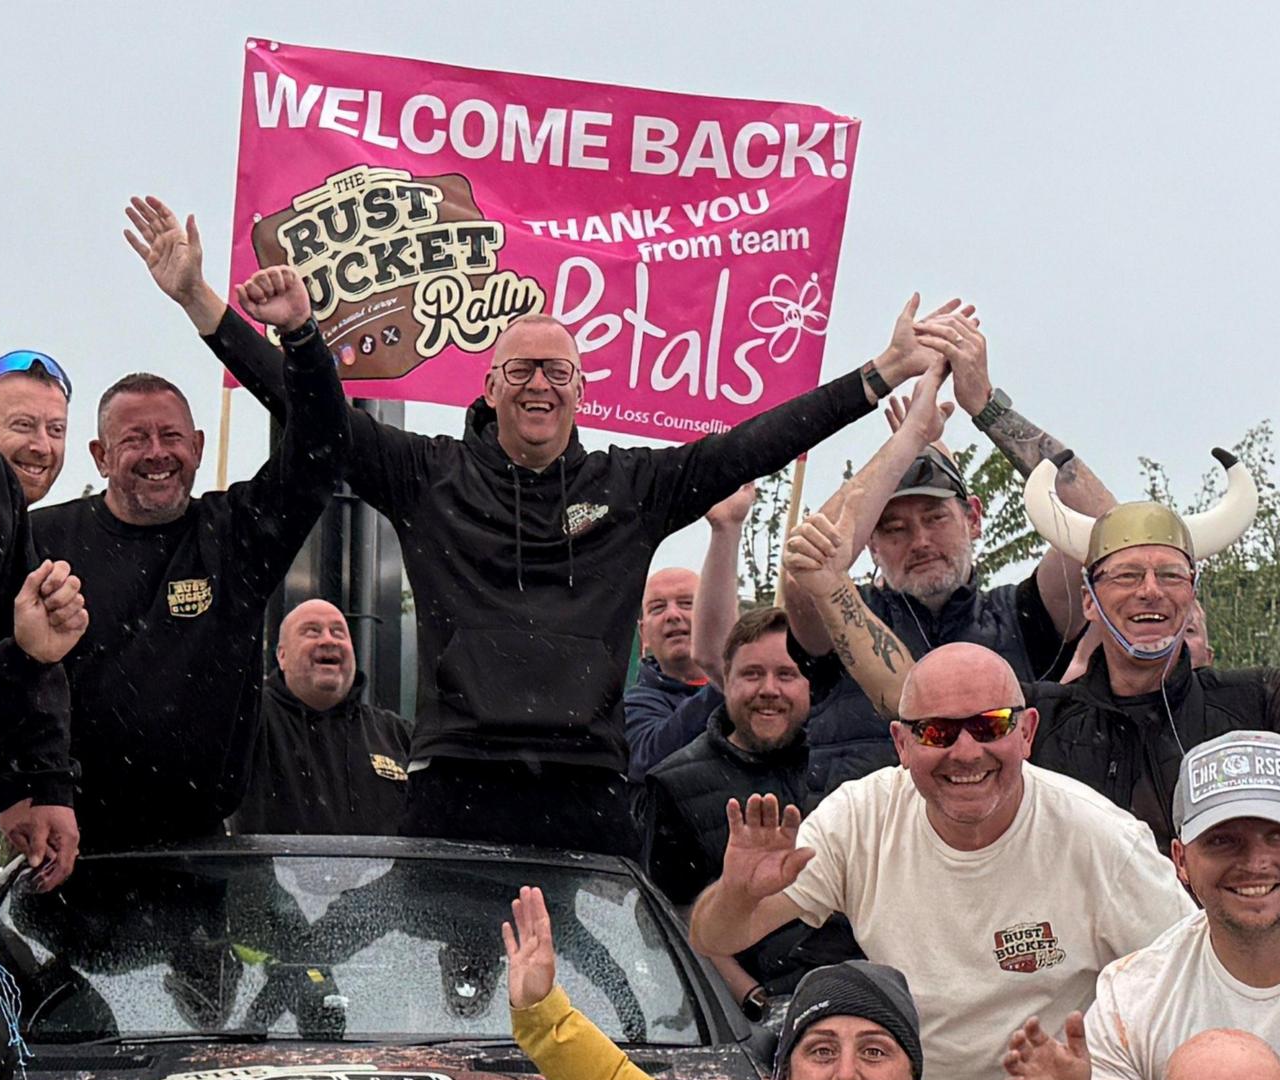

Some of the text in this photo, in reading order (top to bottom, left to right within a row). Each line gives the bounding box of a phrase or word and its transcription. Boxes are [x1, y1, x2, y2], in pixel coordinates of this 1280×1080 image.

[253, 71, 848, 179] WELCOME BACK!
[333, 172, 365, 194] THE
[283, 185, 437, 265] RUST
[522, 188, 770, 243] THANK YOU
[302, 226, 497, 310] UCKET
[637, 226, 809, 263] from team
[422, 275, 537, 350] Rally
[552, 256, 765, 405] Petals
[616, 406, 649, 424] Loss
[653, 411, 734, 434] Counsellin
[995, 939, 1056, 960] BUCKET
[1003, 928, 1043, 944] RUST
